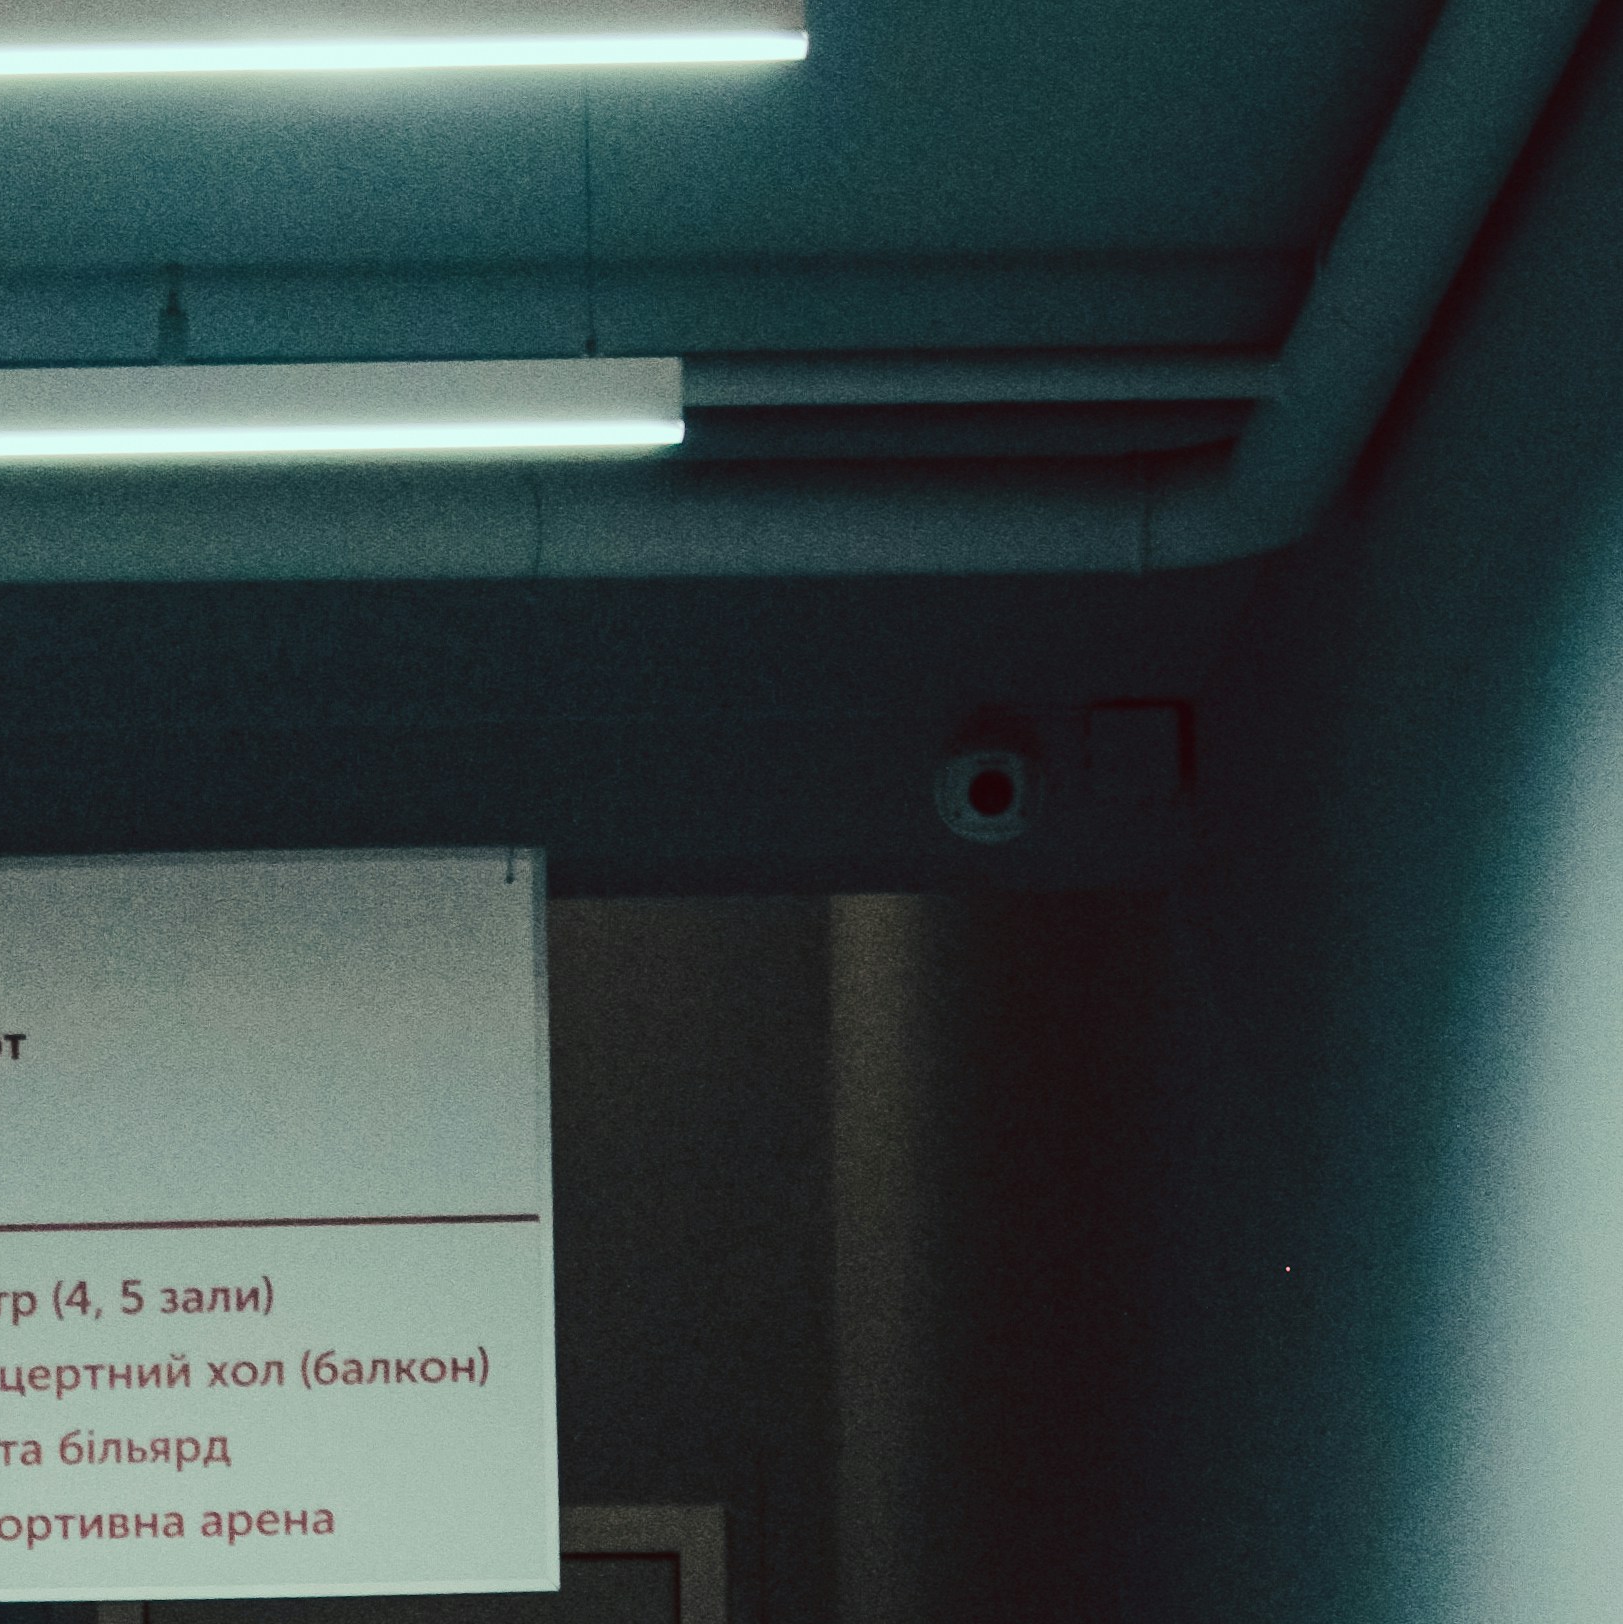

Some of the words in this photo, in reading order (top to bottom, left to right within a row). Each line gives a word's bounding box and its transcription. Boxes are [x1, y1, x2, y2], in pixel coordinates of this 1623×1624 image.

[51, 1279, 103, 1321] (4,
[120, 1279, 145, 1316] 5
[160, 1275, 275, 1317] зали)
[207, 1359, 285, 1388] хол
[300, 1345, 490, 1390] (балкон)
[58, 1429, 233, 1473] більярд
[200, 1507, 336, 1546] арена
